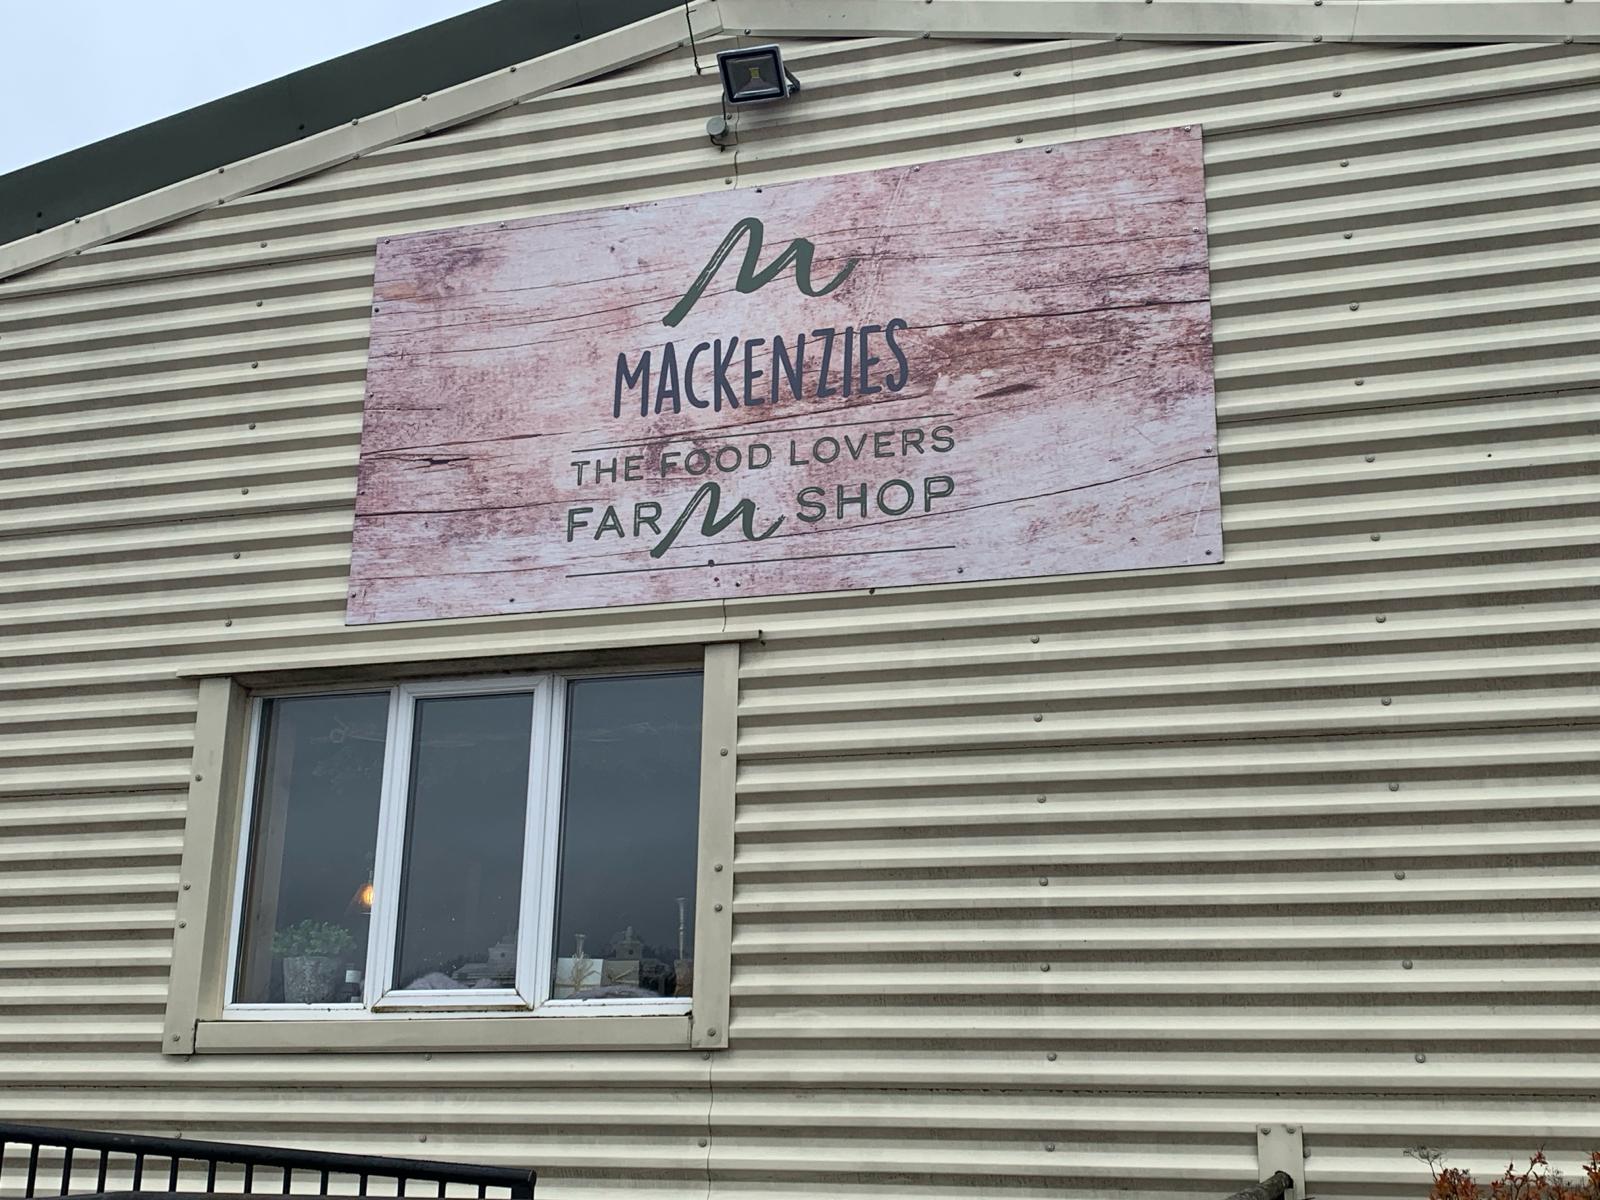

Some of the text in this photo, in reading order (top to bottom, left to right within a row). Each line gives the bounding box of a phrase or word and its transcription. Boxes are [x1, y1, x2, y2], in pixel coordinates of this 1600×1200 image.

[613, 318, 909, 418] MACKENZIES
[571, 425, 955, 486] THE FOOD LOVERS
[796, 475, 956, 523] SHOP
